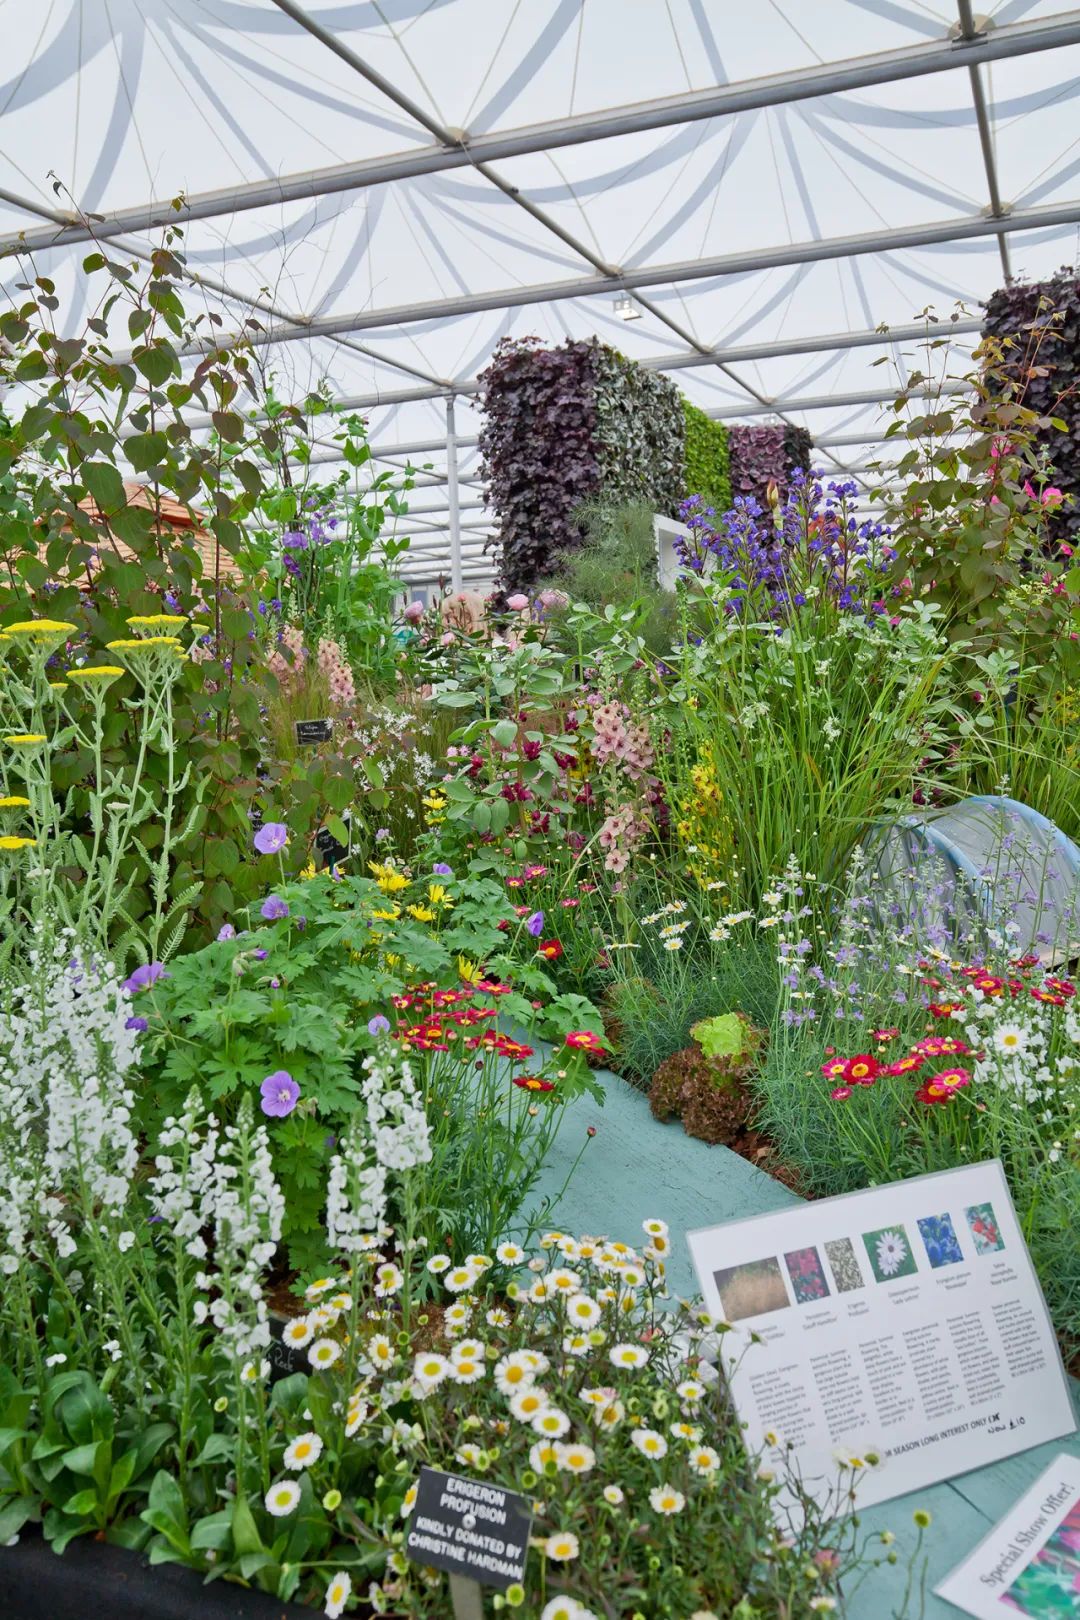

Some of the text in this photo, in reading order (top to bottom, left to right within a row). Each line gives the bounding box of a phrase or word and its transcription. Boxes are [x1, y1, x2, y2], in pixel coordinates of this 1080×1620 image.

[893, 1439, 920, 1456] SEASON
[920, 1433, 939, 1447] LONG
[940, 1423, 969, 1440] INTEREST
[970, 1418, 987, 1430] ONLY
[440, 1493, 506, 1525] PROFUSION
[446, 1477, 506, 1507] ERIGERON
[416, 1515, 522, 1559] KINDLY DONATED BY
[980, 1482, 1076, 1588] Special Show Offer!
[408, 1532, 524, 1580] CHRISTINE HARDMAN
